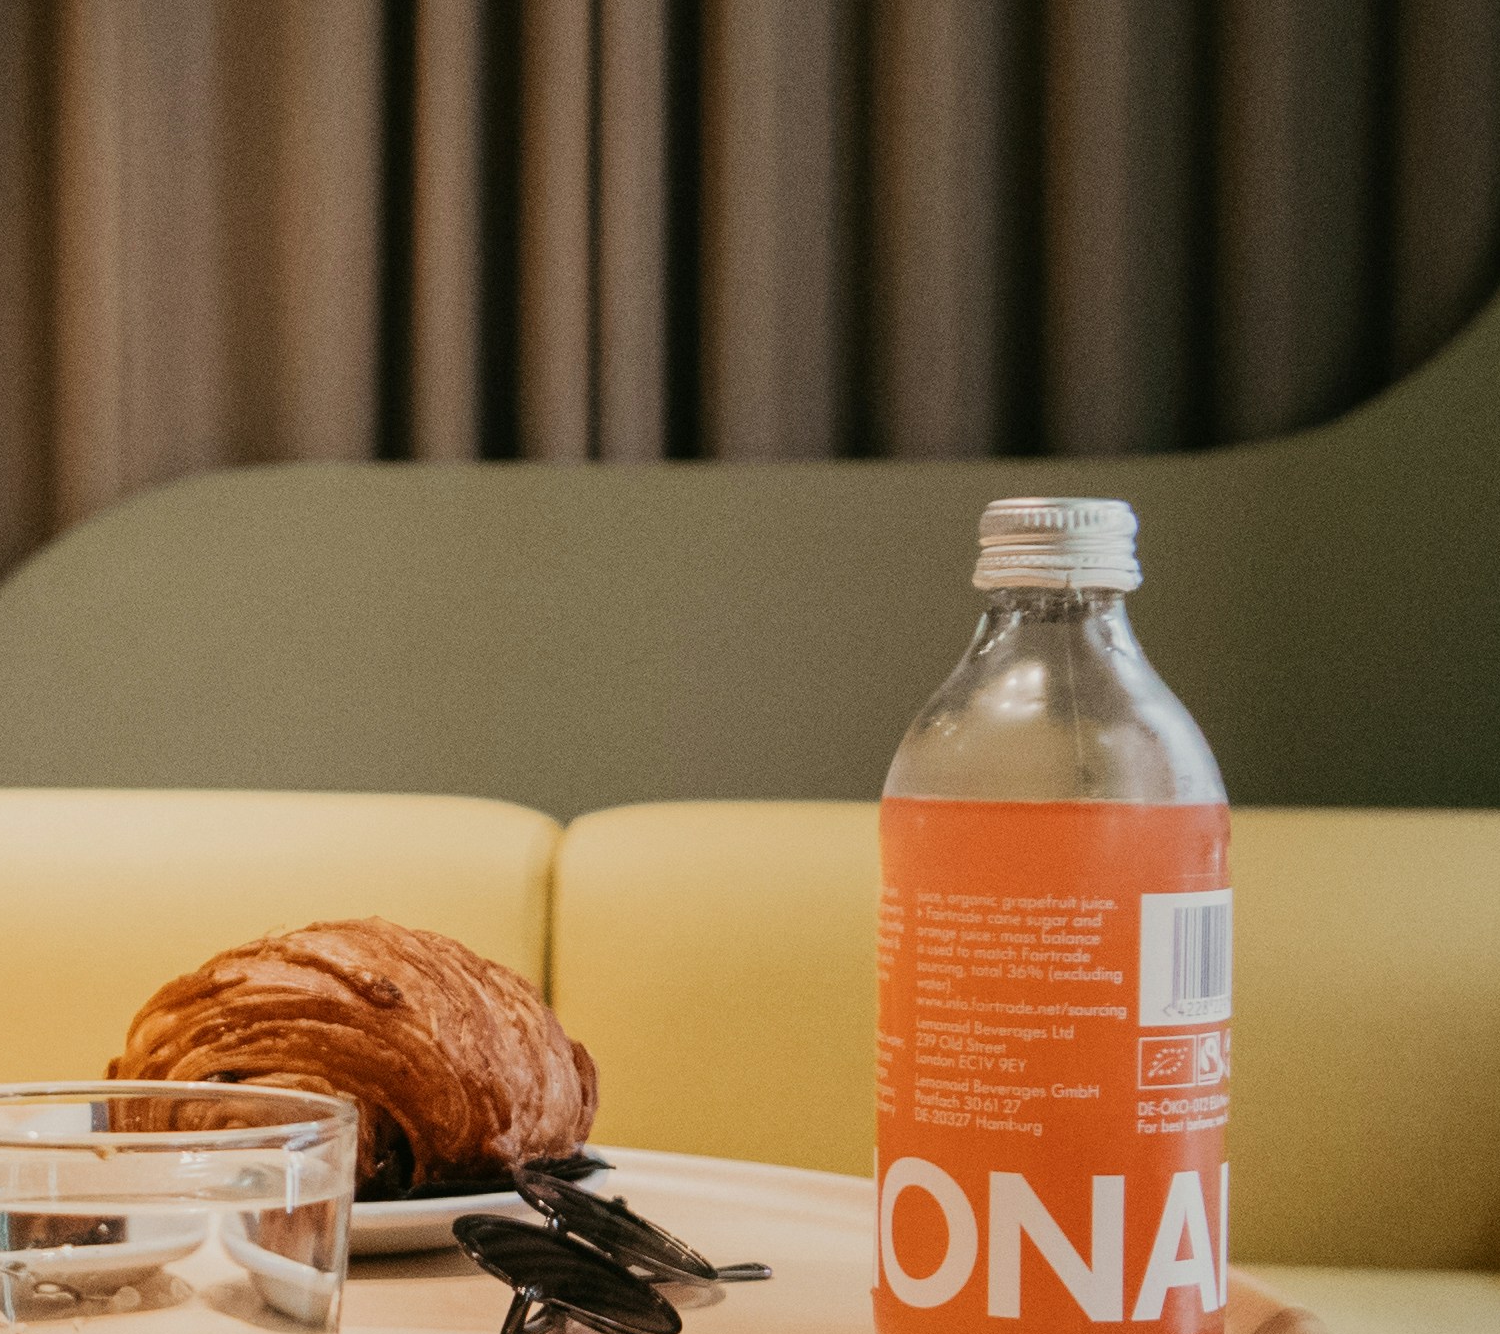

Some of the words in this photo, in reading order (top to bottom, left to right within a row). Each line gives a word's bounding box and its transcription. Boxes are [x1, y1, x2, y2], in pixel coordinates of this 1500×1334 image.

[1002, 893, 1077, 909] grapefruit
[1079, 897, 1119, 912] juice.
[987, 913, 1021, 926] cane
[1026, 916, 1068, 930] sugar
[1072, 914, 1103, 928] and
[1000, 932, 1037, 944] mass
[1042, 930, 1101, 946] balance
[957, 947, 969, 958] to
[974, 947, 1016, 961] match
[1021, 947, 1091, 964] Fairtrade
[971, 965, 1003, 979] total
[1049, 966, 1123, 985] (excluding
[974, 1020, 1048, 1042] Beverages
[1052, 1024, 1075, 1040] Ltd
[916, 1031, 937, 1047] 239
[939, 1033, 963, 1050] Old
[966, 1038, 1007, 1054] Street
[915, 1051, 955, 1068] London
[958, 1054, 995, 1071] EC1V
[1000, 1057, 1028, 1073] 9EY
[973, 1078, 1047, 1100] Beverages
[1051, 1083, 1101, 1099] GmbH
[1004, 1099, 1021, 1114] 27
[976, 1115, 1043, 1137] Hamburg
[1138, 1119, 1158, 1133] For
[873, 1147, 1229, 1323] ONA
